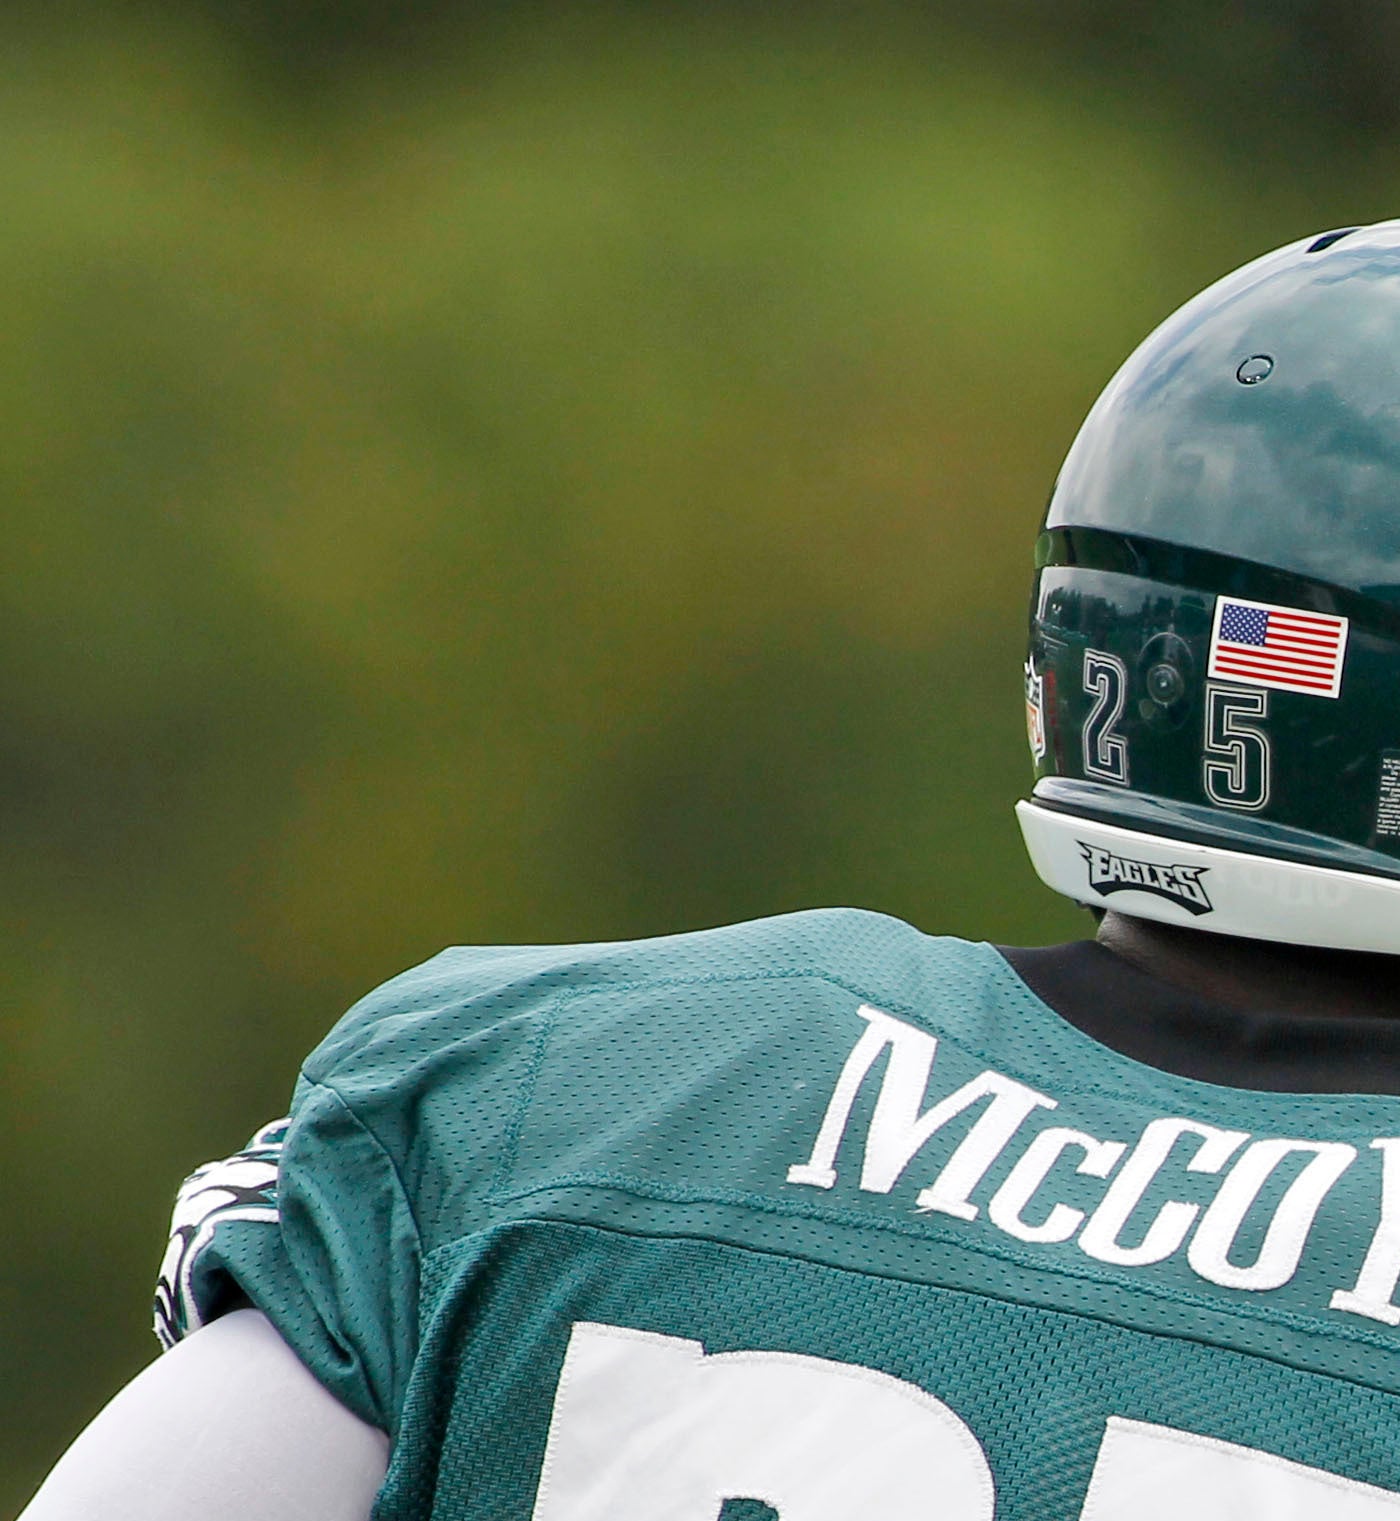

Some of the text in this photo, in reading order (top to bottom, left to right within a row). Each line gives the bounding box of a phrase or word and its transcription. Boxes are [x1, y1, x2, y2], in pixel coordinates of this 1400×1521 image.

[1083, 647, 1130, 787] 2
[1203, 680, 1271, 811] 5
[1075, 840, 1215, 915] EAGLES
